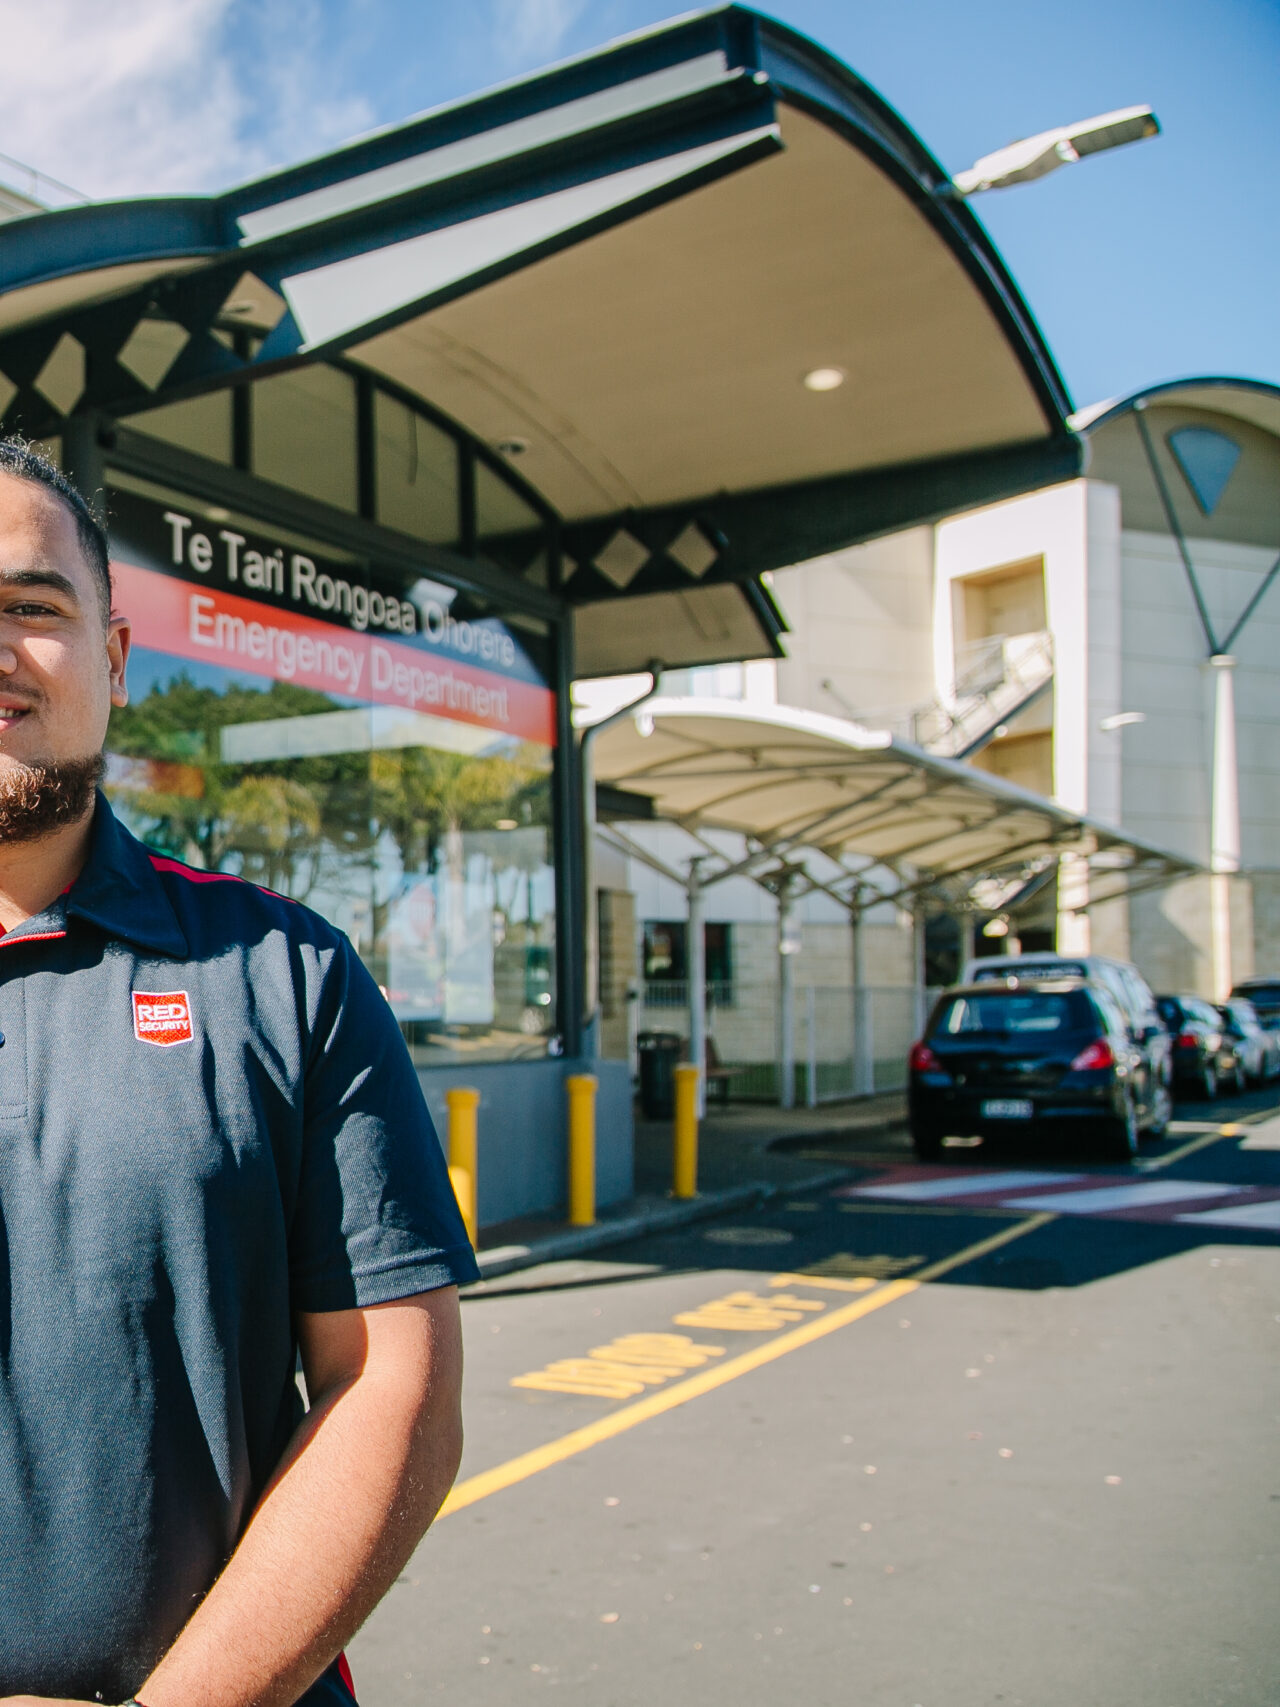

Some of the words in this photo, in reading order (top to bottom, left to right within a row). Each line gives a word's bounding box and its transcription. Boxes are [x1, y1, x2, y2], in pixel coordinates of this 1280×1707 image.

[163, 511, 213, 573] Te
[219, 530, 284, 595] Tari
[290, 554, 416, 634] Rongoaa
[190, 593, 364, 693] Emergency
[370, 645, 509, 722] Department
[137, 1004, 187, 1021] RED
[138, 1020, 189, 1032] SECURITY
